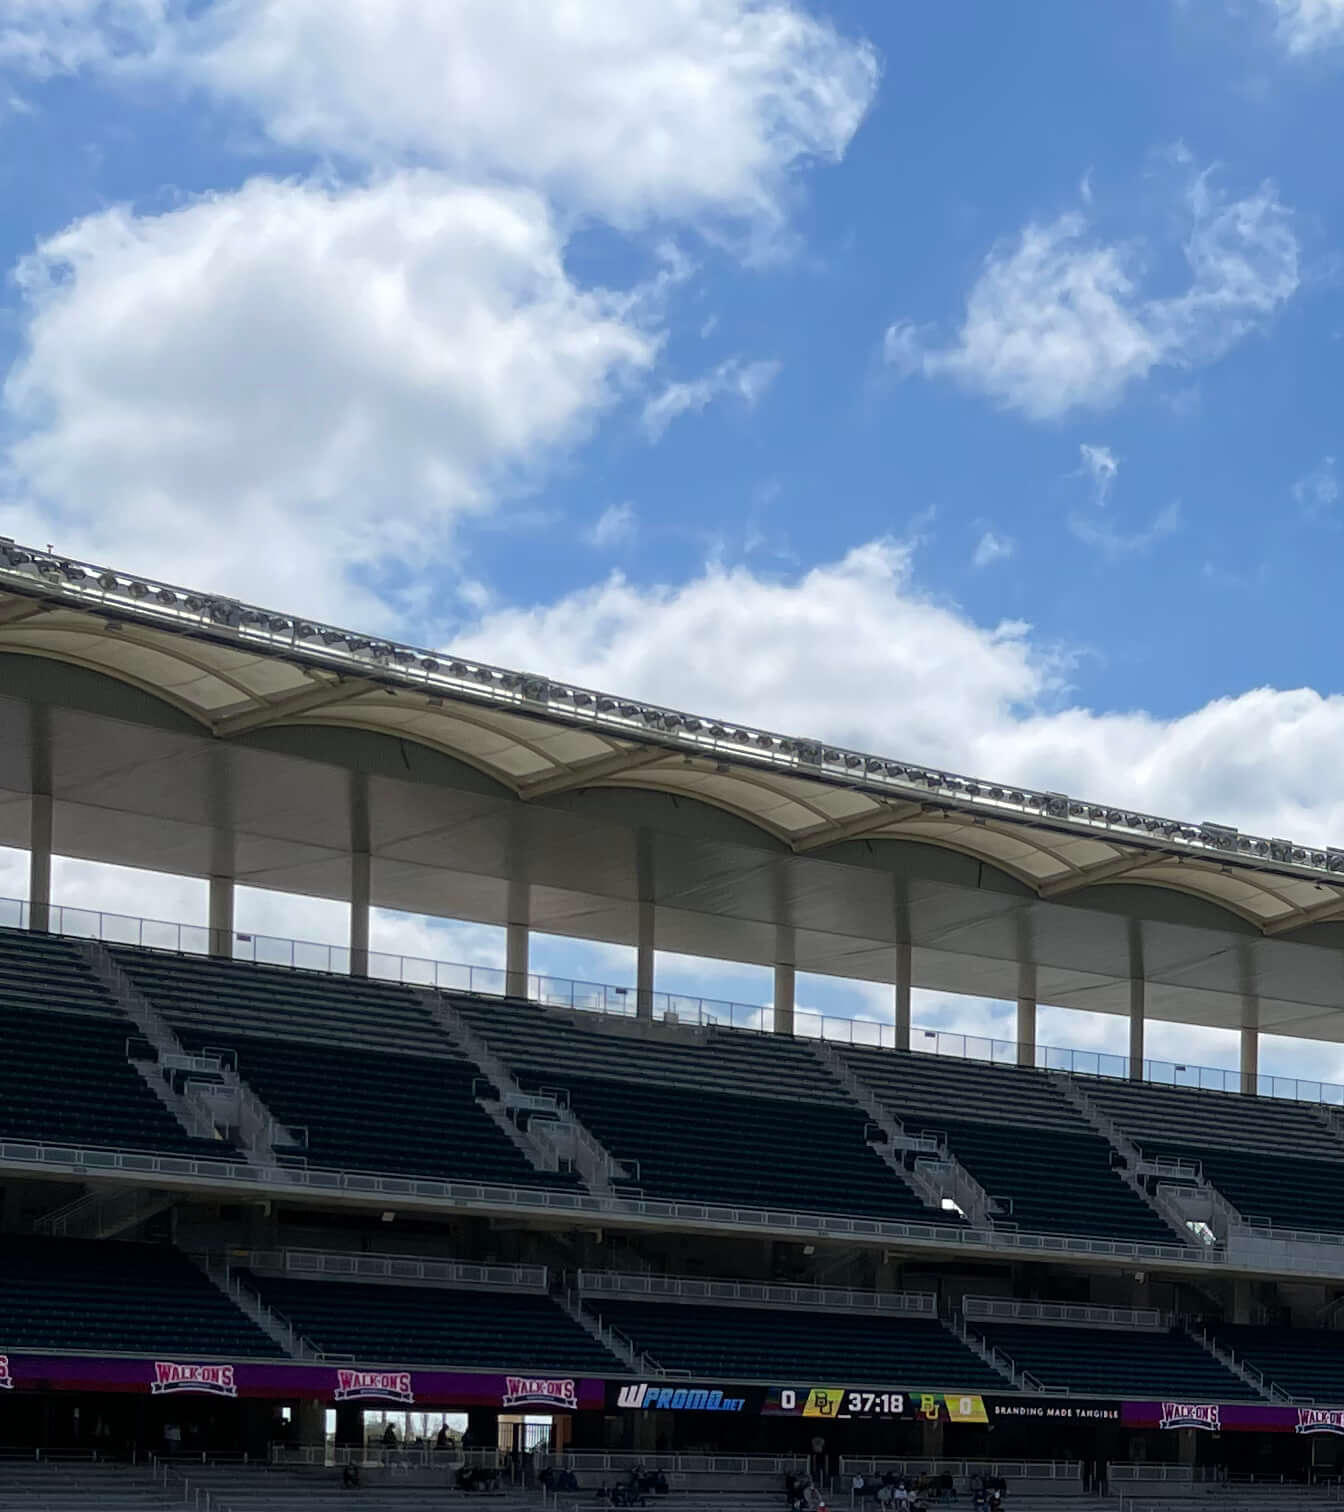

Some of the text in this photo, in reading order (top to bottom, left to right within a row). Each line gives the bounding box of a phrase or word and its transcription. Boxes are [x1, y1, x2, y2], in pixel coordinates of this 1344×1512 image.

[781, 1390, 796, 1409] 0
[848, 1393, 904, 1413] 37:18
[959, 1398, 970, 1415] 0
[995, 1406, 1043, 1417] BRANDING
[1047, 1407, 1073, 1417] MADE
